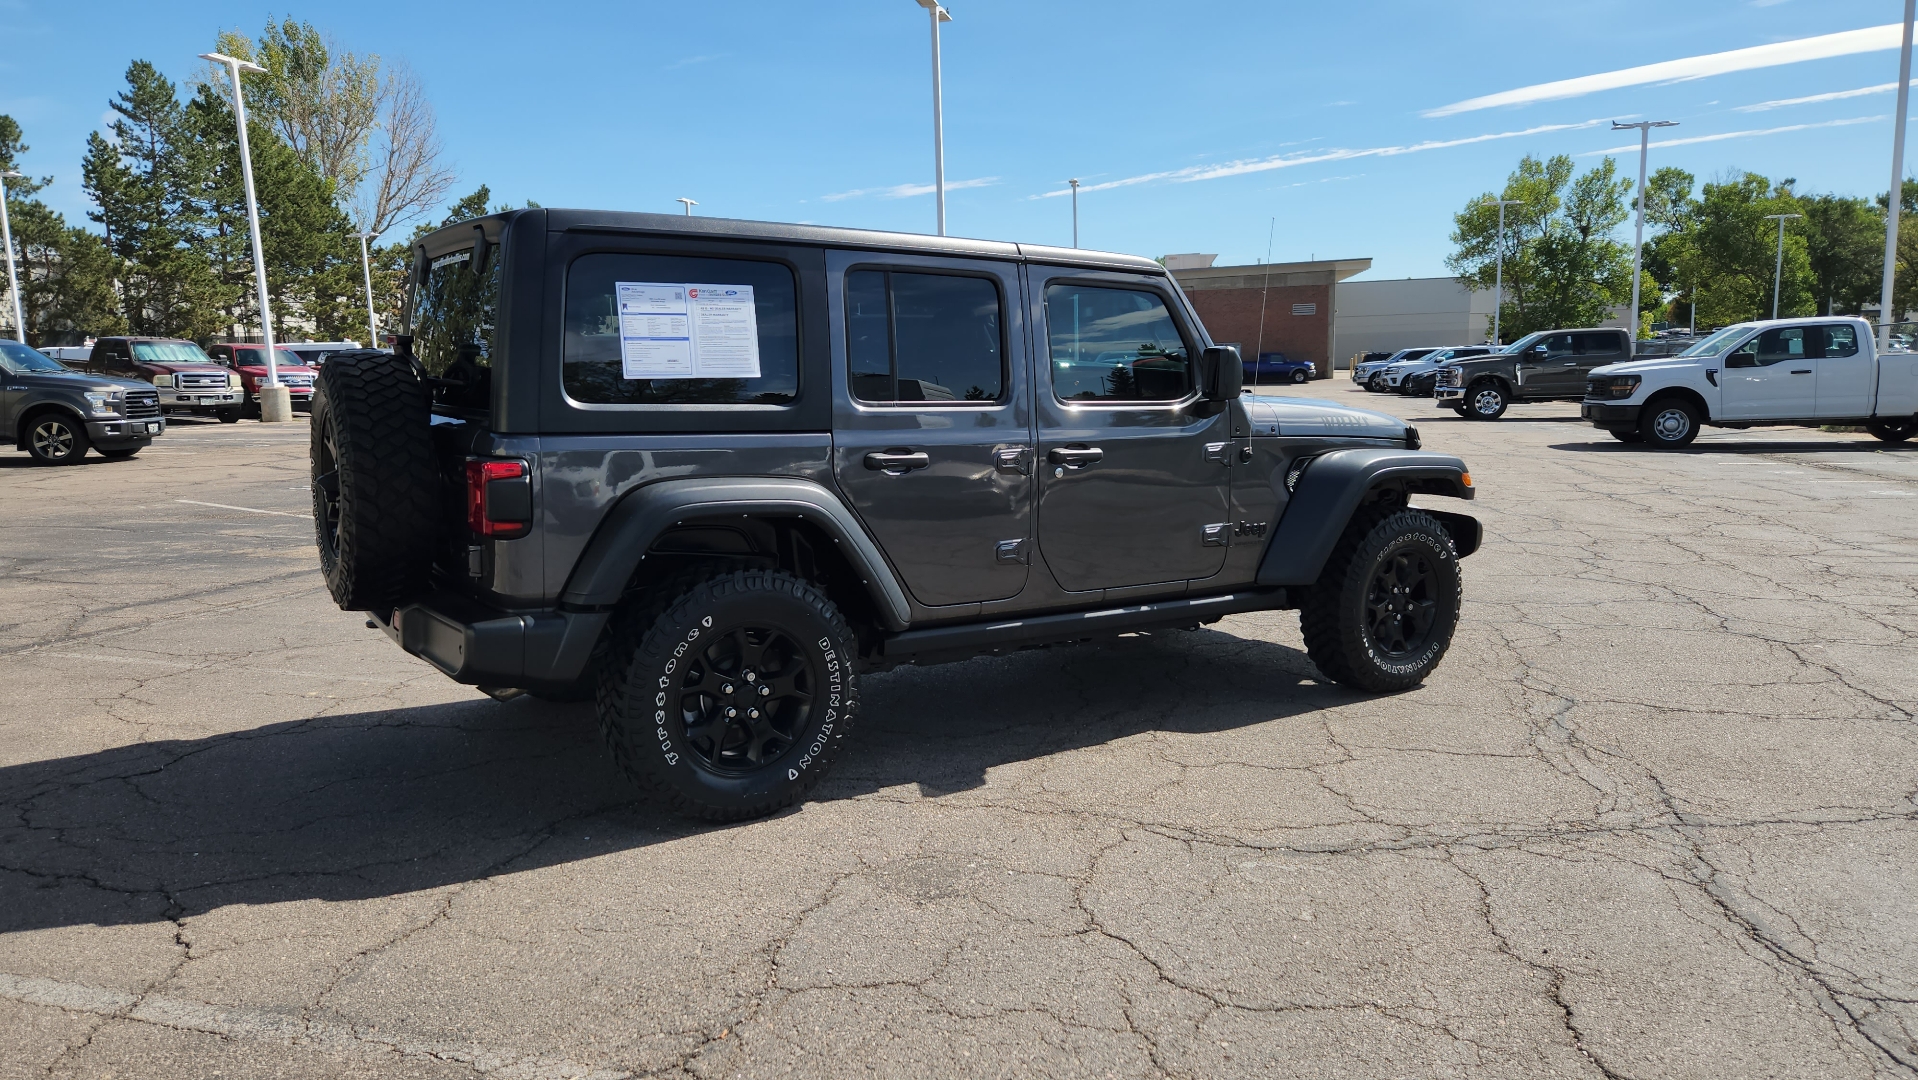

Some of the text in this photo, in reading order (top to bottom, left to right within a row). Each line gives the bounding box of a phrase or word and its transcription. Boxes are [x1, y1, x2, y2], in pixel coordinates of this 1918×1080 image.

[1234, 520, 1267, 538] Jeep
[1376, 531, 1441, 562] Firestone
[1373, 641, 1440, 675] DESTINATION
[655, 627, 700, 766] Firestone
[799, 636, 842, 770] DESTINATION
